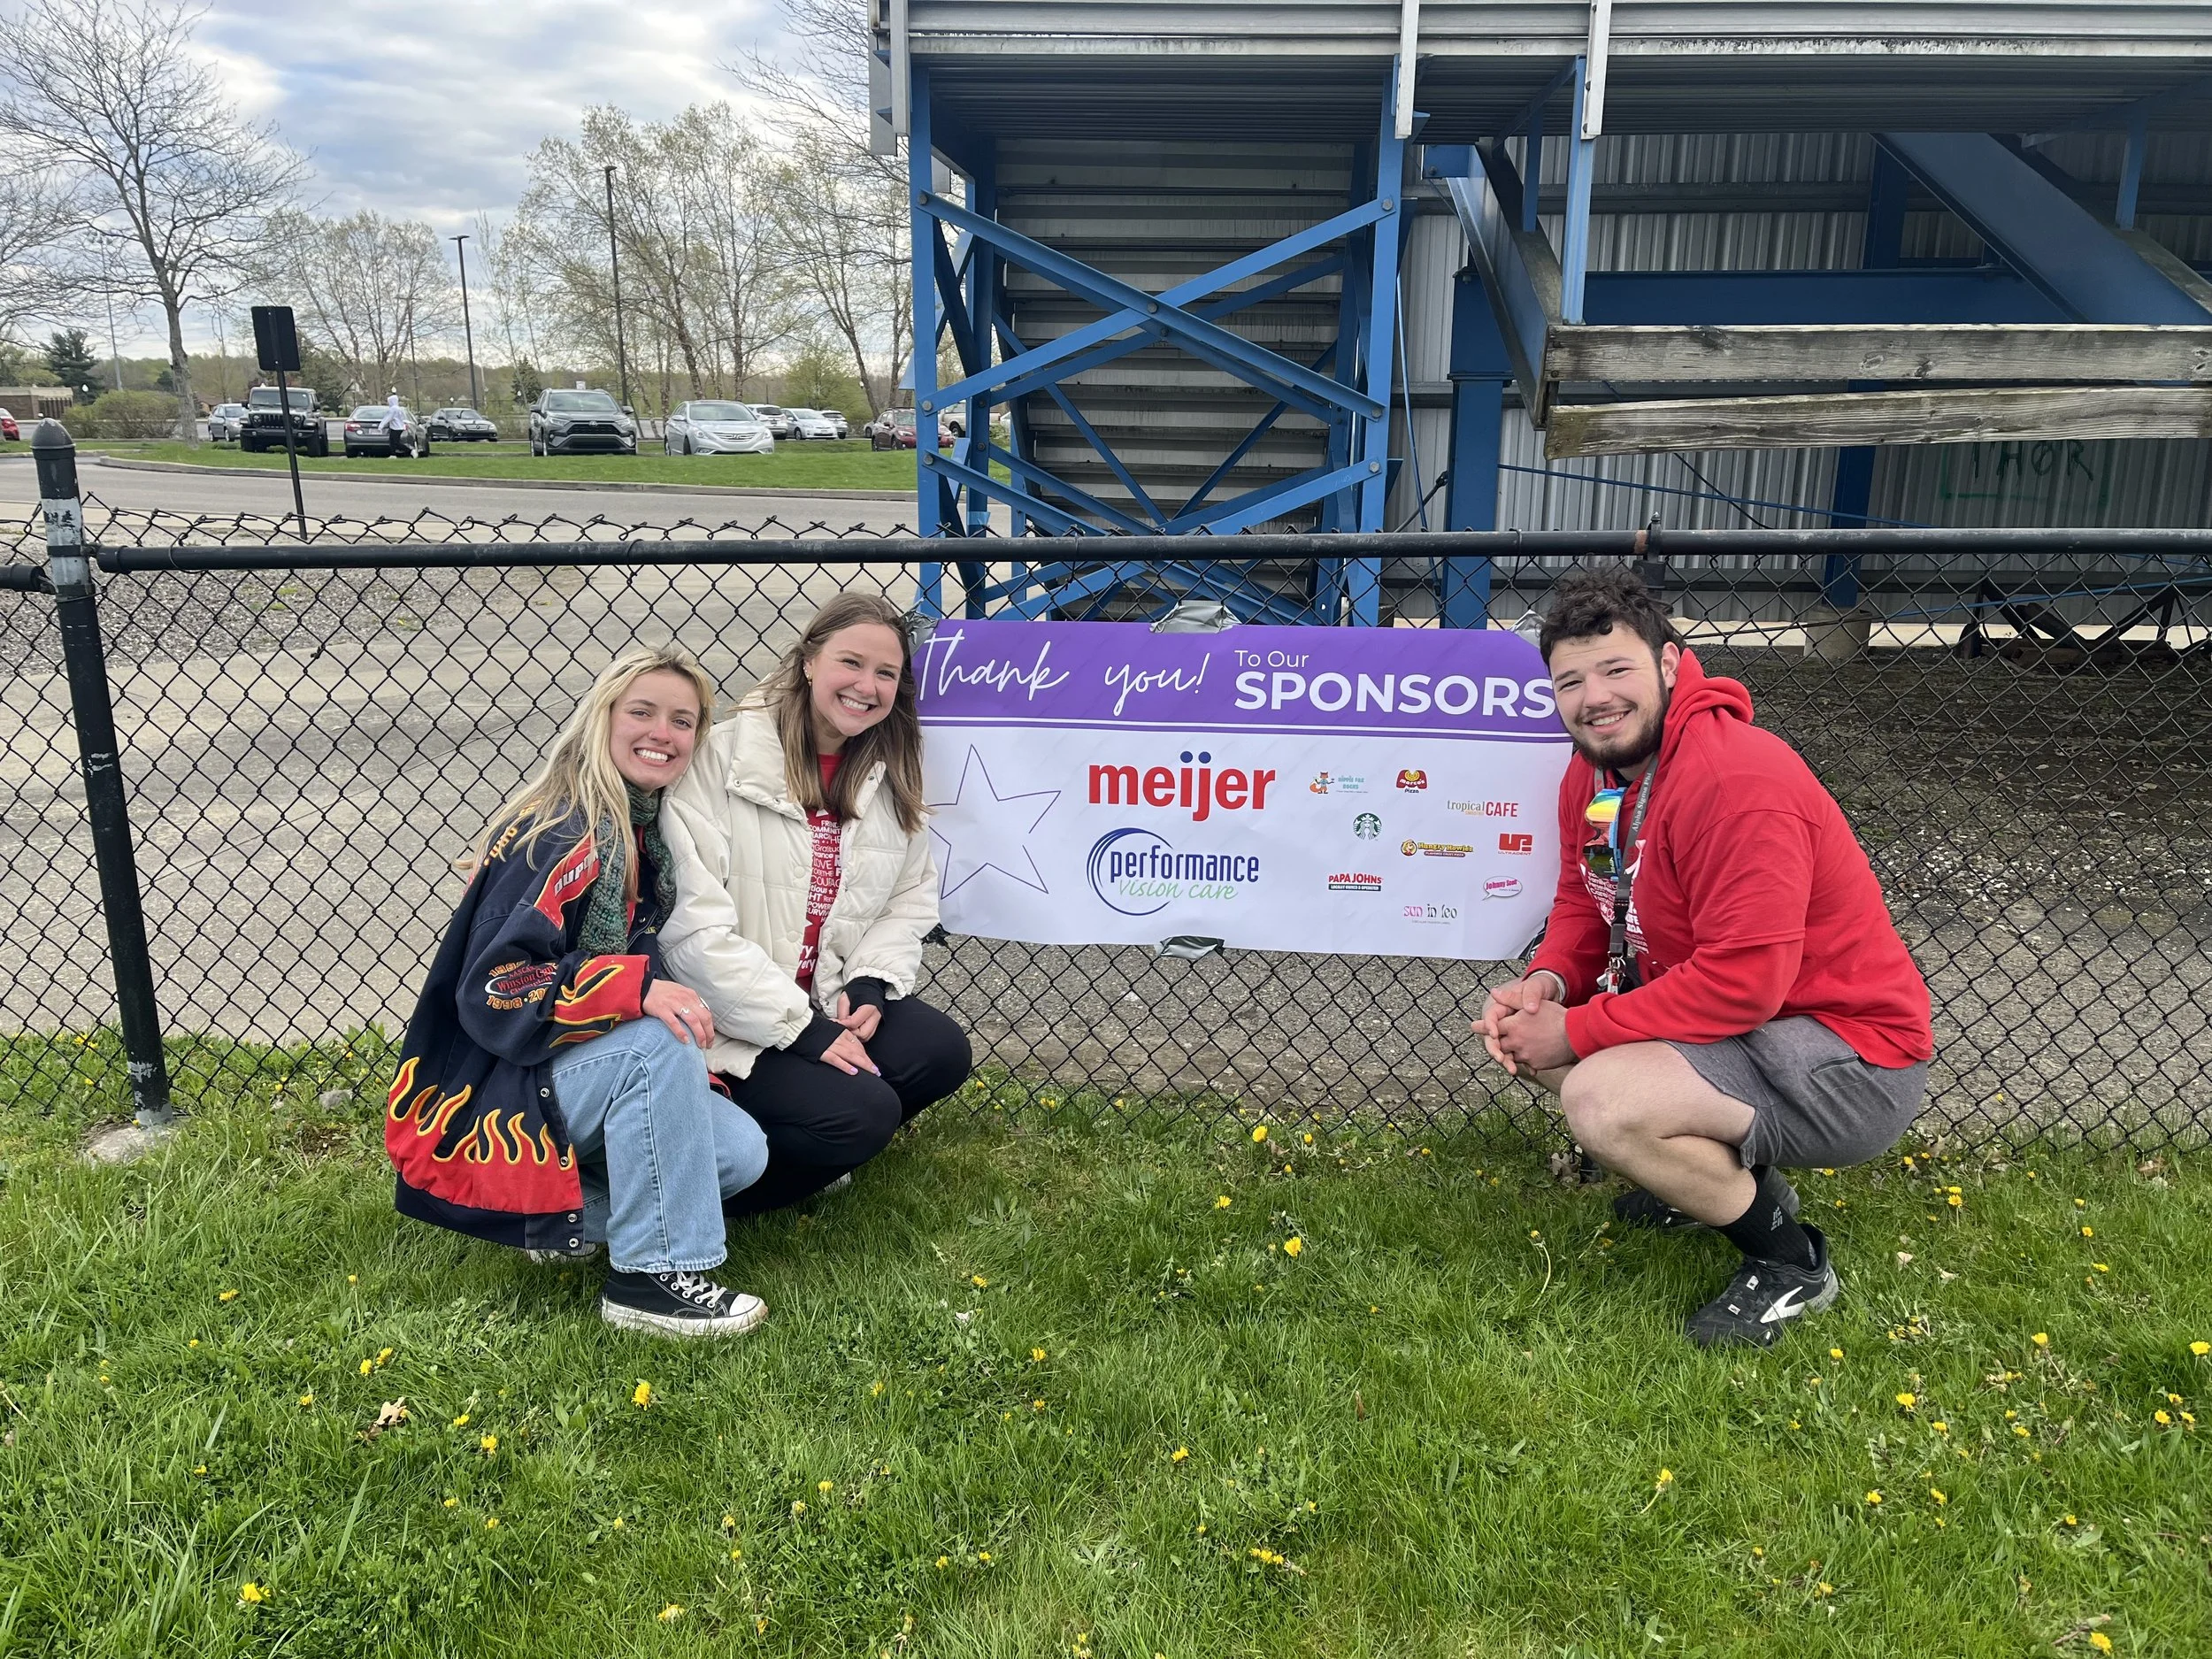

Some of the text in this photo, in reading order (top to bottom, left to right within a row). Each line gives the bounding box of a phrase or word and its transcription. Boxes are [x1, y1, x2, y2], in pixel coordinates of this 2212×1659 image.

[1234, 649, 1310, 668] To Our
[919, 628, 1210, 716] Thank you!
[1234, 671, 1556, 719] SPONSORS
[1088, 750, 1276, 822] meijer
[1447, 799, 1519, 817] tropical CAFE
[1632, 772, 1653, 833] Alpha Sigma Phi
[1417, 842, 1446, 851] Hungry
[1110, 844, 1259, 883] performance
[1328, 873, 1382, 884] PAPA JOHNS
[1188, 880, 1240, 901] care
[1403, 905, 1423, 918] sun
[1426, 903, 1437, 918] in
[496, 973, 536, 992] Winston
[486, 995, 523, 1010] 1998
